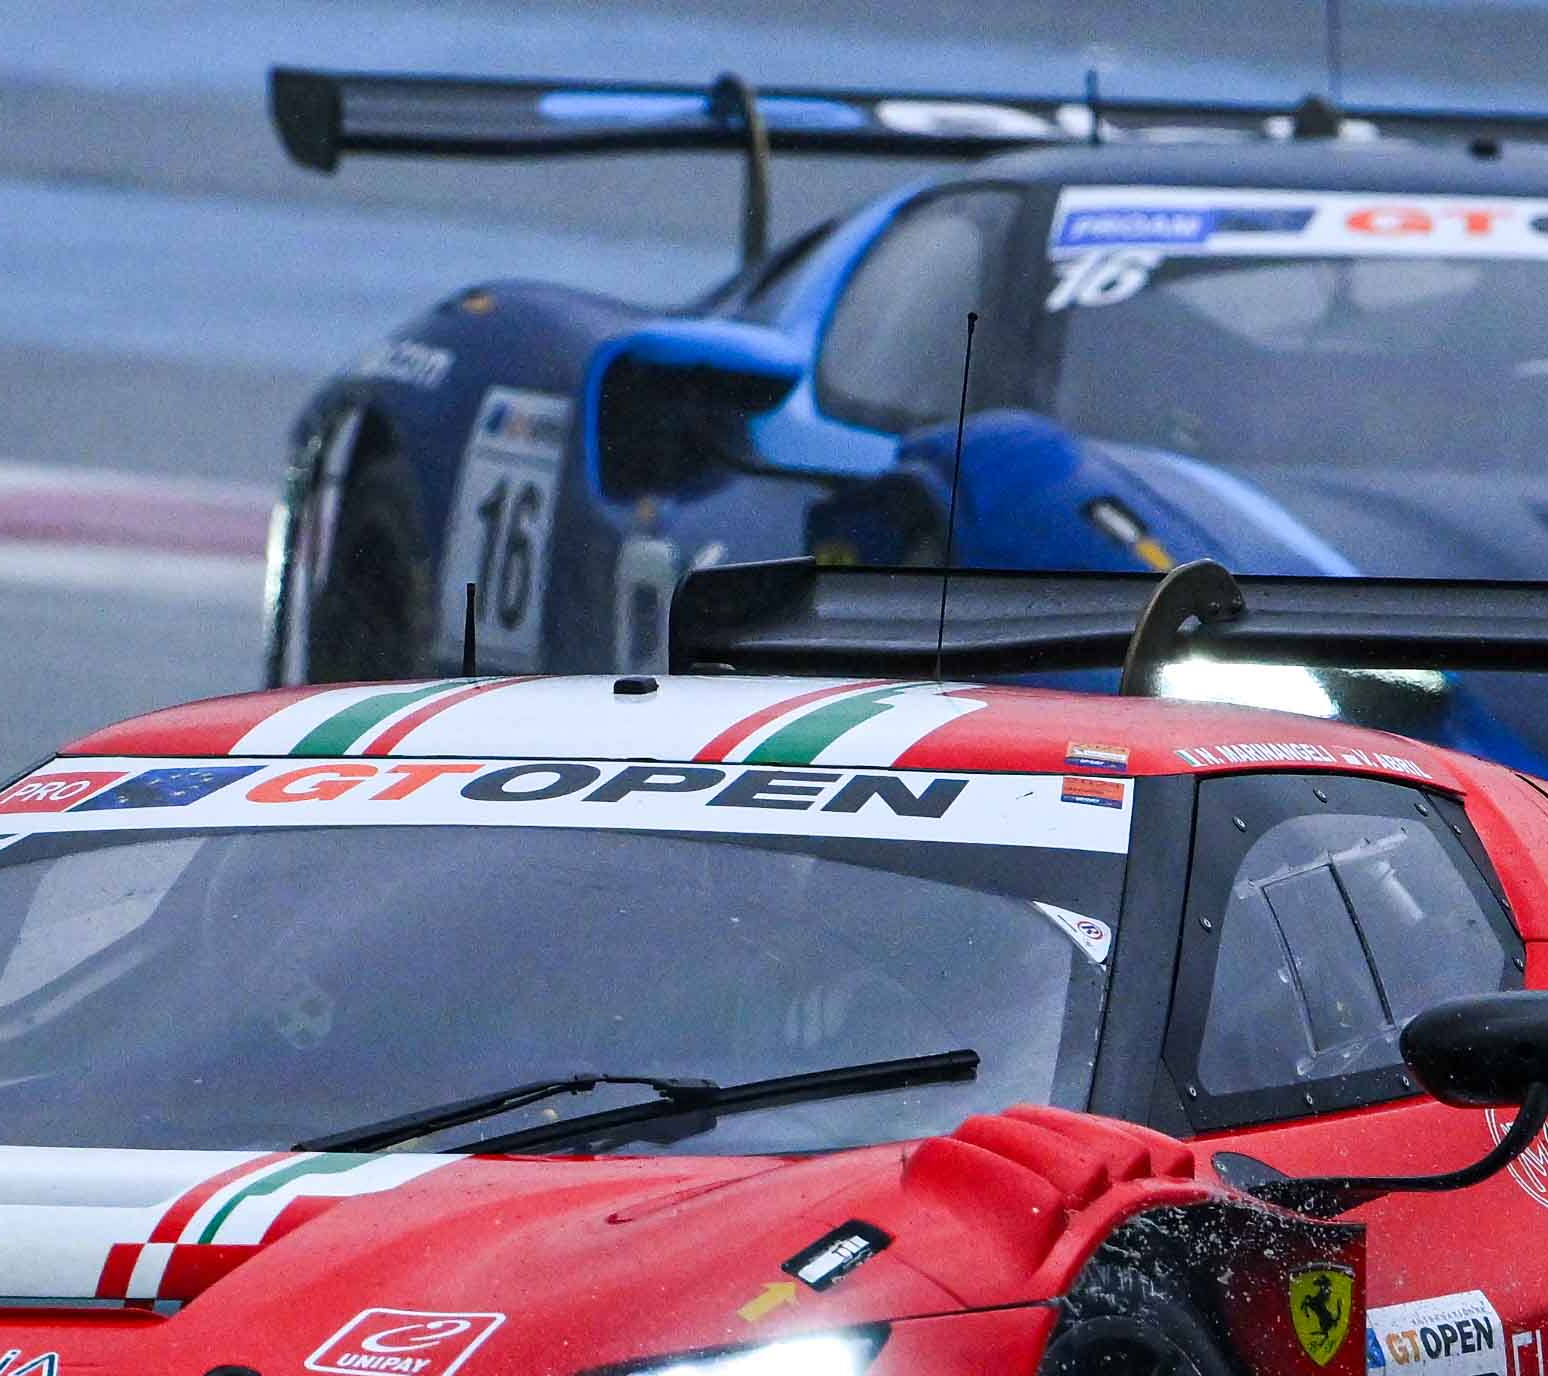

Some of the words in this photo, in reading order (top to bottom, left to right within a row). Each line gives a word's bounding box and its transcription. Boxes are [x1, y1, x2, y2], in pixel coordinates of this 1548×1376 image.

[1046, 248, 1164, 312] 16
[475, 479, 544, 628] 16
[1, 779, 85, 804] PRO
[336, 1352, 432, 1373] UNIPAY
